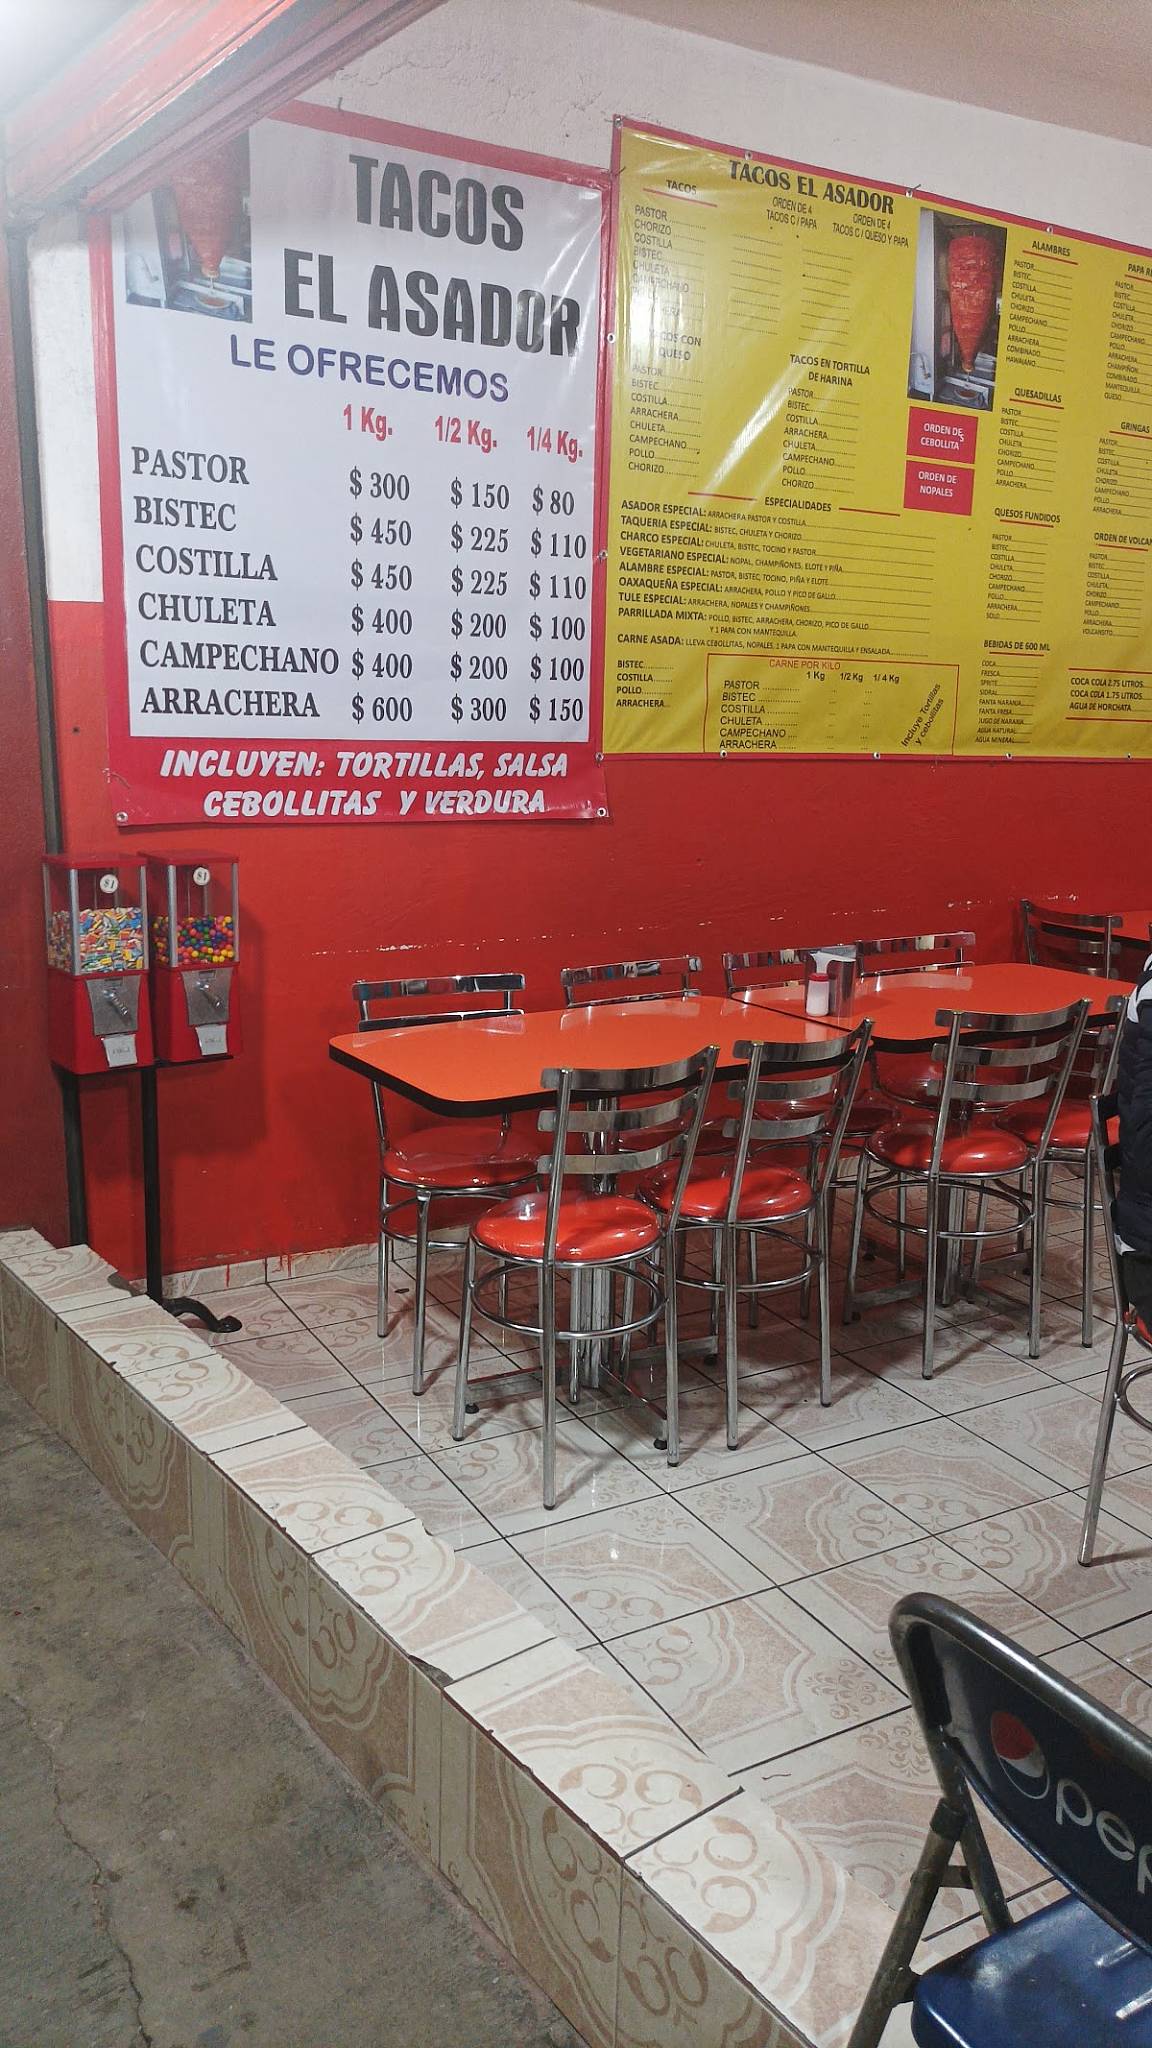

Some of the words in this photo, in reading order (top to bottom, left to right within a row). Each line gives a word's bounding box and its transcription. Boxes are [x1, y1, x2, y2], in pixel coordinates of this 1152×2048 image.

[666, 179, 697, 195] TACOS
[730, 160, 791, 190] TACOS
[798, 176, 817, 198] EL
[823, 183, 894, 214] ASADOR
[349, 154, 524, 251] TACOS
[773, 197, 796, 212] ORDEN
[798, 202, 807, 213] DE
[808, 204, 812, 214] 4
[635, 205, 667, 221] PASTOR
[767, 209, 788, 222] TACOS
[800, 217, 817, 230] PAPA
[635, 219, 671, 235] CHORIZO
[634, 233, 672, 249] COSTILLA
[1032, 241, 1070, 257] ALAMBRES
[284, 248, 347, 324] EL
[368, 266, 581, 357] ASADOR
[231, 335, 276, 371] LE
[287, 344, 509, 403] OFRECEMOS
[790, 354, 818, 366] TACOS
[821, 358, 831, 368] EN
[832, 360, 870, 375] TORTILLA
[808, 371, 818, 381] DE
[820, 374, 853, 387] HARINA
[1015, 388, 1062, 403] QUESADILLAS
[630, 406, 679, 421] ARRACHERA
[630, 420, 665, 432] CHULETA
[784, 427, 828, 440] ARRACHERA
[924, 423, 950, 435] ORDEN
[952, 427, 962, 436] DE
[1120, 422, 1150, 433] GRINGAS
[342, 405, 353, 430] 1
[361, 407, 393, 442] Kg.
[435, 416, 462, 443] 1/2
[467, 420, 497, 454] Kg.
[527, 426, 551, 452] 1/4
[557, 430, 583, 464] Kg.
[630, 434, 686, 449] CAMPECHANO
[629, 448, 654, 459] POLLO
[783, 453, 834, 466] CAMPECHANO
[629, 462, 664, 474] CHORIZO
[131, 446, 249, 485] PASTOR
[370, 472, 410, 501] 300
[472, 482, 509, 510] 150
[550, 490, 574, 516] 80
[782, 478, 814, 489] CHORIZO
[918, 471, 945, 483] ORDEN
[946, 474, 957, 484] DE
[920, 485, 953, 497] NOPALES
[621, 500, 660, 512] ASADOR
[663, 504, 706, 516] ESPECIAL:
[764, 497, 832, 512] ESPECIALIDADES
[994, 507, 1024, 519] QUESOS
[1024, 512, 1061, 523] FUNDIDOS
[134, 495, 236, 532] BISTEC
[371, 519, 412, 547] 450
[470, 526, 508, 553] 225
[550, 533, 586, 559] 110
[621, 515, 667, 528] TAQUERIA
[670, 520, 712, 533] ESPECIAL:
[620, 531, 659, 543] CHARCO
[661, 534, 703, 547] ESPECIAL:
[620, 546, 684, 560] VEGETARIANO
[687, 552, 729, 564] ESPECIAL:
[136, 544, 277, 581] COSTILLA
[372, 564, 412, 592] 450
[470, 570, 508, 596] 225
[550, 574, 586, 600] 110
[619, 562, 664, 573] ALAMBRE
[667, 565, 709, 577] ESPECIAL:
[619, 577, 678, 590] OAXAQUEÑA
[681, 580, 722, 592] ESPECIAL:
[618, 592, 640, 602] TULE
[644, 594, 686, 605] ESPECIAL:
[138, 593, 276, 627] CHULETA
[372, 609, 412, 635] 400
[470, 613, 507, 639] 200
[550, 615, 585, 641] 100
[618, 608, 673, 619] PARRILLADA
[675, 610, 707, 621] MIXTA:
[617, 634, 648, 644] CARNE
[651, 636, 684, 645] ASADA:
[984, 640, 1013, 649] BEBIDAS
[1014, 641, 1024, 649] DE
[1025, 642, 1038, 650] 600
[1039, 643, 1050, 651] ML
[140, 640, 339, 674] CAMPECHANO
[372, 653, 412, 679] 400
[469, 655, 508, 681] 200
[550, 657, 584, 682] 100
[617, 660, 644, 669] BISTEC
[769, 659, 799, 669] CARNE
[801, 661, 820, 669] POR
[822, 661, 841, 670] KILO
[617, 673, 653, 682] COSTILLA
[813, 671, 825, 681] Kg
[840, 673, 851, 681] 1/2
[852, 673, 863, 682] Kg
[1070, 677, 1089, 686] COCA
[1091, 678, 1107, 687] COLA
[1121, 679, 1144, 688] LITROS
[617, 686, 642, 694] POLLO
[724, 680, 760, 690] PASTOR
[616, 699, 664, 708] ARRACHERA
[722, 692, 756, 702] BISTEC
[142, 688, 320, 718] ARRACHERA
[372, 697, 412, 722] 600
[470, 697, 507, 723] 300
[549, 697, 583, 722] 150
[721, 705, 765, 714] COSTILLA
[720, 715, 763, 727] CHULETA
[902, 716, 923, 748] Incluye
[920, 683, 941, 716] Tortillas
[719, 727, 786, 739] CAMPECHANO
[719, 738, 777, 750] ARRACHERA
[160, 749, 325, 778] INCLUYEN:
[337, 752, 485, 780] TORTILLAS,
[494, 753, 568, 777] SALSA
[204, 790, 381, 817] CEBOLLITAS
[399, 791, 418, 814] Y
[424, 791, 545, 815] VERDURA
